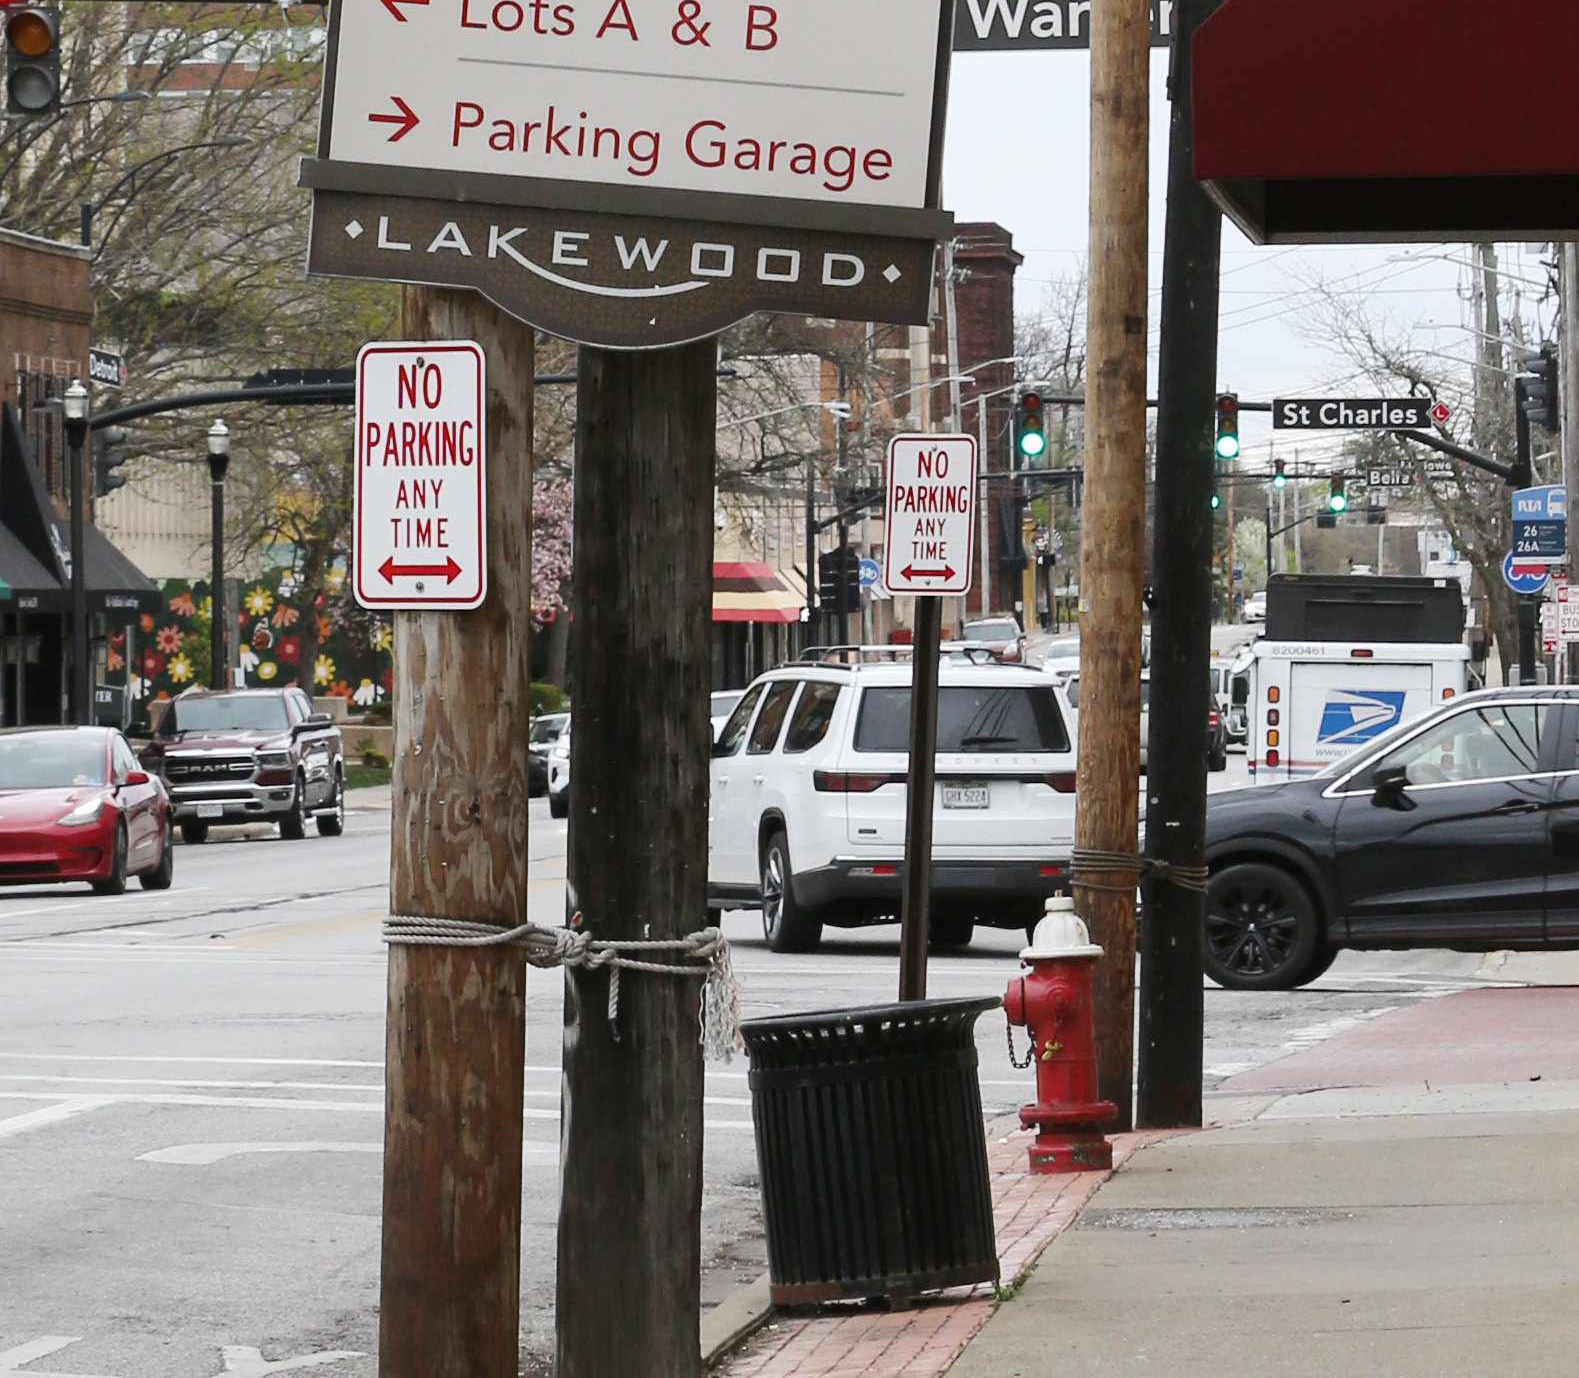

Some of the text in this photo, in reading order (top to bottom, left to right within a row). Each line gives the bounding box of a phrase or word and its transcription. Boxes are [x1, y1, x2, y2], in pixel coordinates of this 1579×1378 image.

[671, 0, 711, 47] &
[746, 5, 778, 51] B
[452, 101, 893, 192] Parking Garage
[377, 216, 866, 298] LAKEWOOD
[398, 363, 442, 409] NO
[1283, 401, 1418, 426] St Charles
[366, 420, 474, 466] PARKING
[917, 451, 949, 479] NO
[396, 479, 443, 509] ANY
[894, 485, 968, 514] PARKING
[391, 517, 449, 549] TIME
[914, 517, 947, 537] ANY
[1523, 525, 1538, 537] 26
[912, 541, 948, 560] TIME
[1516, 540, 1540, 553] 26A
[189, 764, 227, 772] RAM
